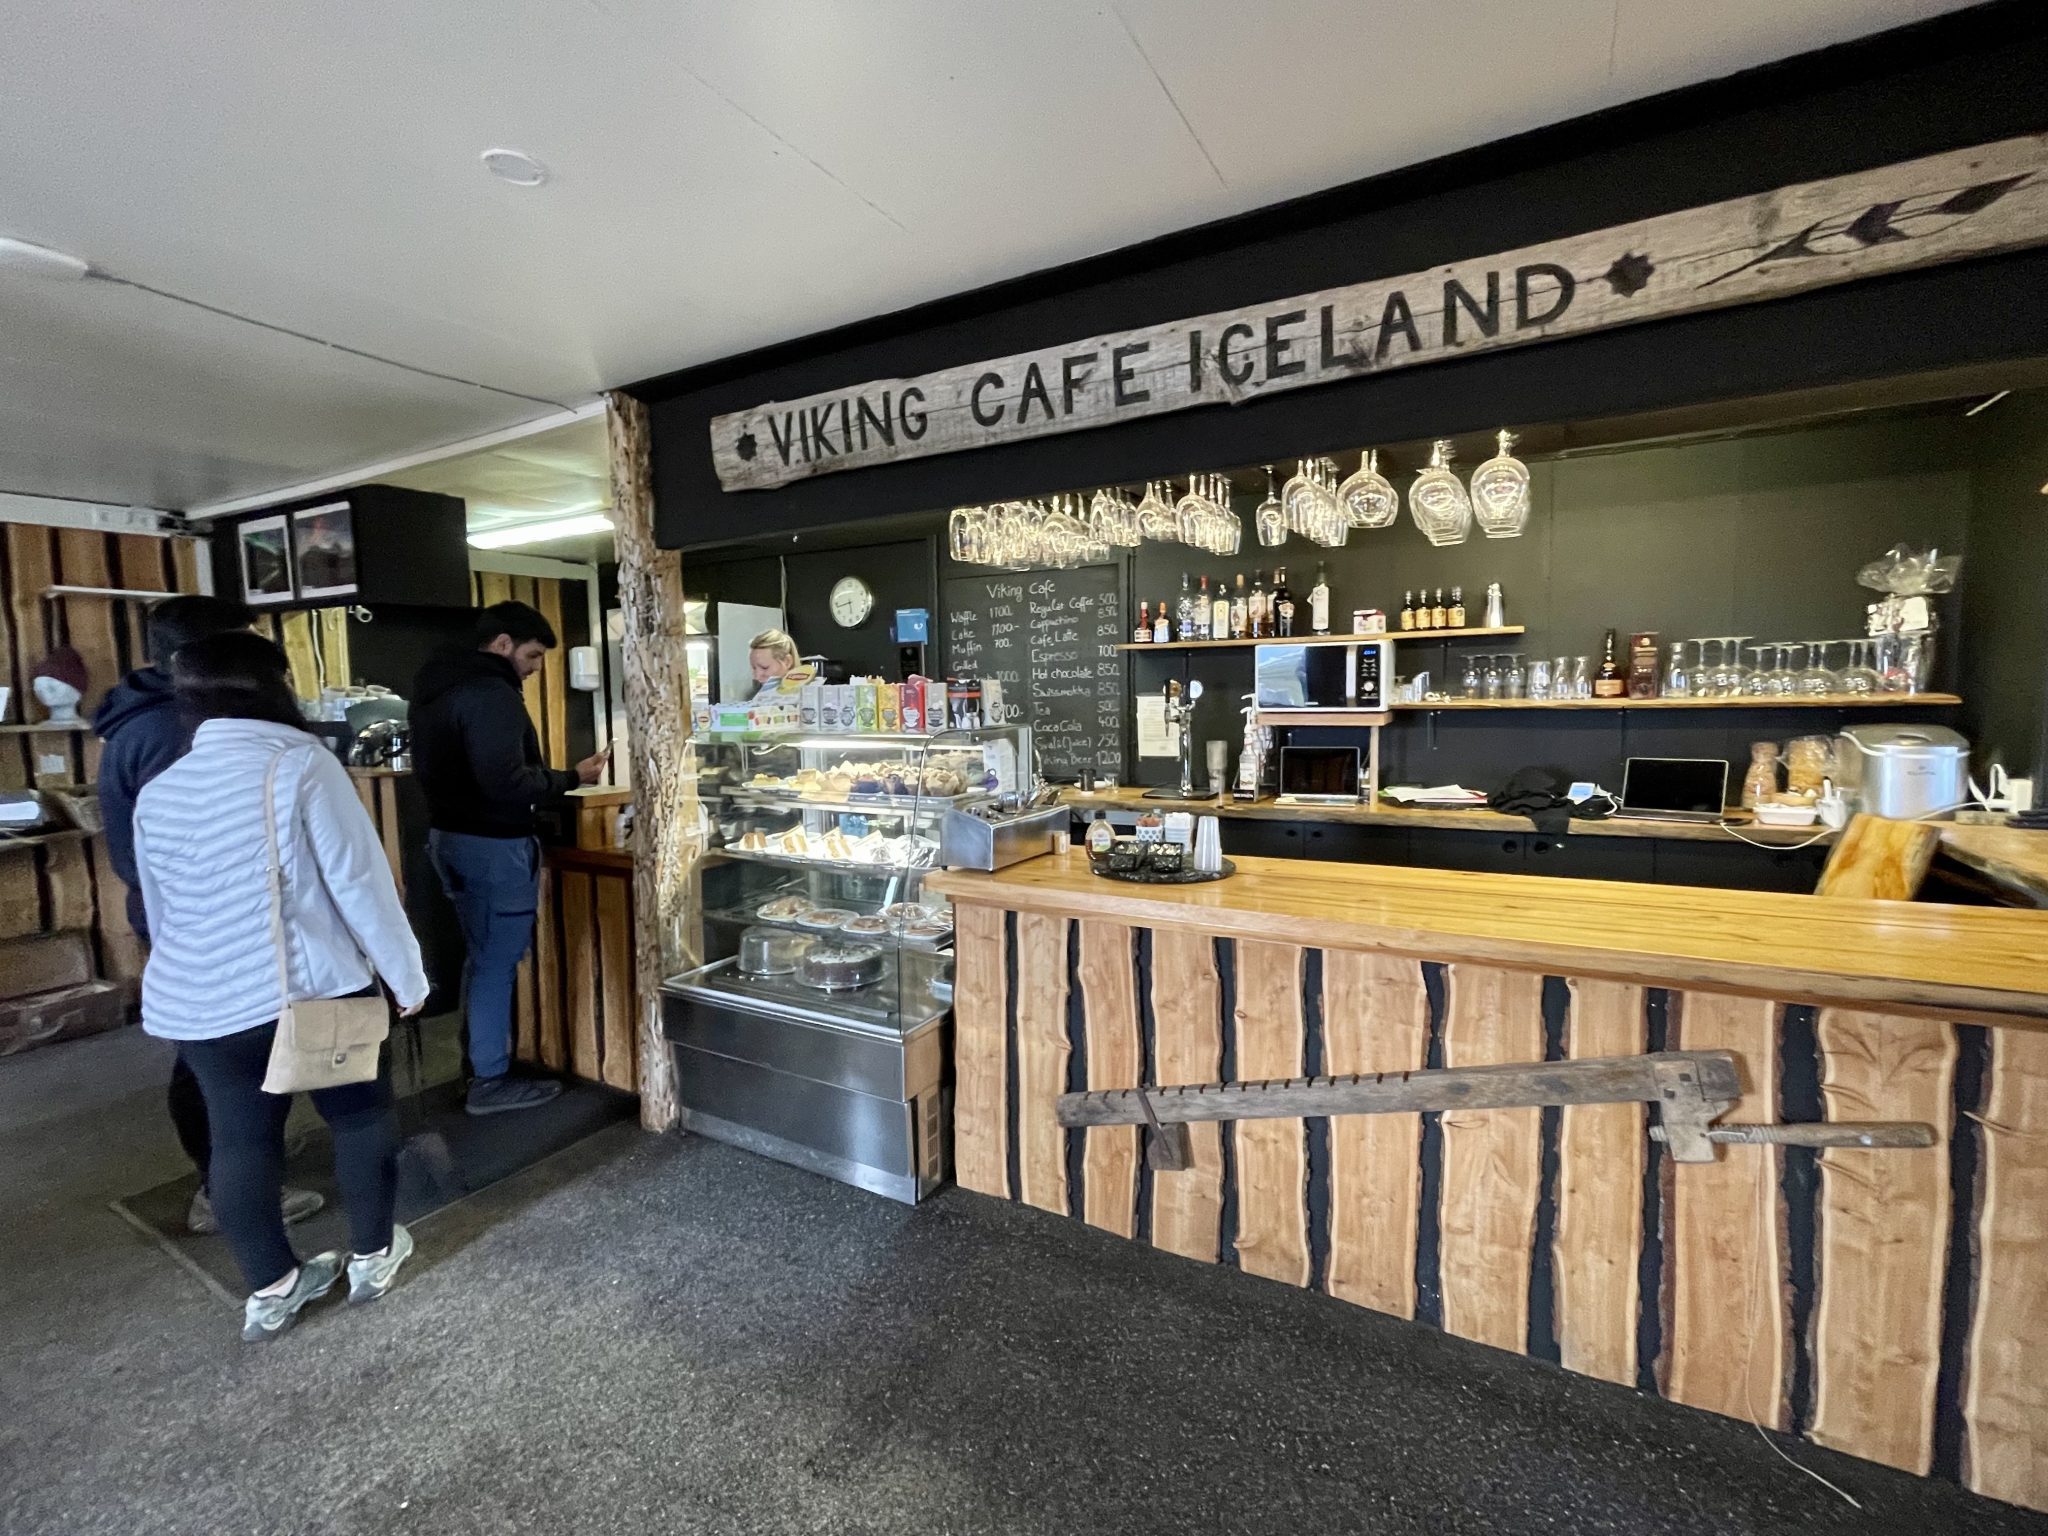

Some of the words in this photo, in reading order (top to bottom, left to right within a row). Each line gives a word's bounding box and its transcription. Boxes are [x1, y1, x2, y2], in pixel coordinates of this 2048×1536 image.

[767, 387, 928, 467] VIKING
[970, 341, 1150, 427] CAFE
[1189, 263, 1575, 394] ICELAND
[986, 583, 1023, 603] Viking
[1029, 579, 1056, 600] Cafe
[1029, 599, 1065, 618] Regular
[950, 610, 978, 626] Waffle
[951, 628, 976, 641] Cake
[1030, 633, 1053, 647] Cafe
[951, 640, 983, 657] Muffin
[1031, 648, 1078, 666] Espresso
[952, 660, 978, 672] Grilled
[1032, 667, 1048, 680] Hot
[1050, 665, 1094, 679] chocolate
[1032, 701, 1051, 716] Tea
